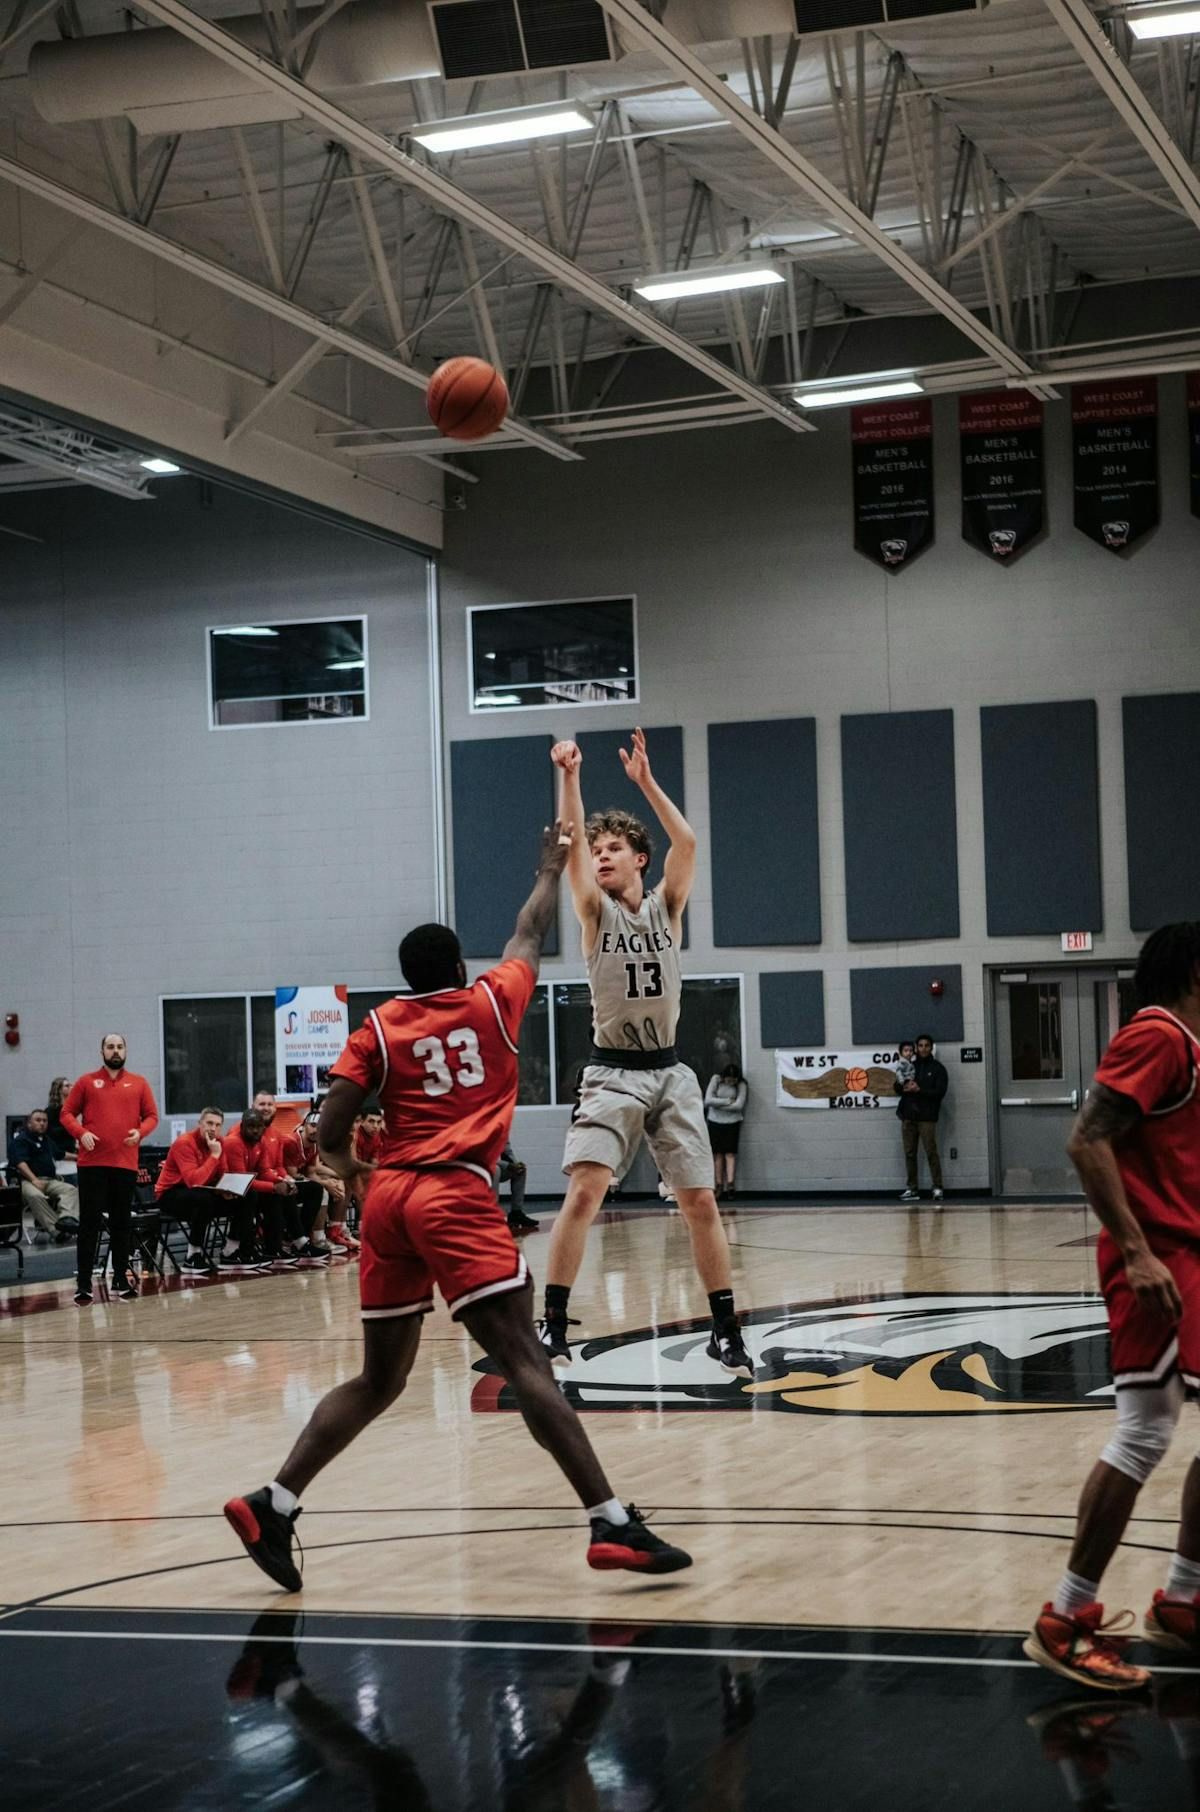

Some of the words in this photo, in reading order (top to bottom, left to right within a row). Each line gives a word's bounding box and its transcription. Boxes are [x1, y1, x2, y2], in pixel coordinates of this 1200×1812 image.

[1083, 393, 1110, 403] WEST
[1112, 389, 1144, 401] COAST
[971, 404, 997, 414] WEST
[999, 400, 1030, 411] COAST
[1072, 408, 1110, 420] BAPTIST
[1112, 403, 1155, 416] COLLEGE
[862, 413, 887, 424] WEST
[889, 410, 920, 422] COAST
[960, 418, 997, 430] BAPTIST
[999, 415, 1041, 426] COLLEGE
[889, 424, 931, 437] COLLEGE
[1097, 426, 1132, 438] MEN'S
[984, 437, 1018, 448] MEN'S
[1078, 440, 1152, 455] BASKETBALL
[875, 446, 909, 458] MEN'S
[965, 449, 1037, 464] BASKETBALL
[857, 459, 927, 474] BASKETBALL
[1102, 464, 1127, 476] 2014
[989, 475, 1015, 486] 2016
[601, 927, 673, 954] EAGLES
[1067, 932, 1088, 948] EXIT
[624, 961, 664, 1000] 13
[307, 1010, 343, 1024] JOSHUA
[412, 1026, 485, 1097] 33
[794, 1055, 838, 1068] WEST
[872, 1052, 900, 1064] COA
[828, 1096, 880, 1109] EAGLES
